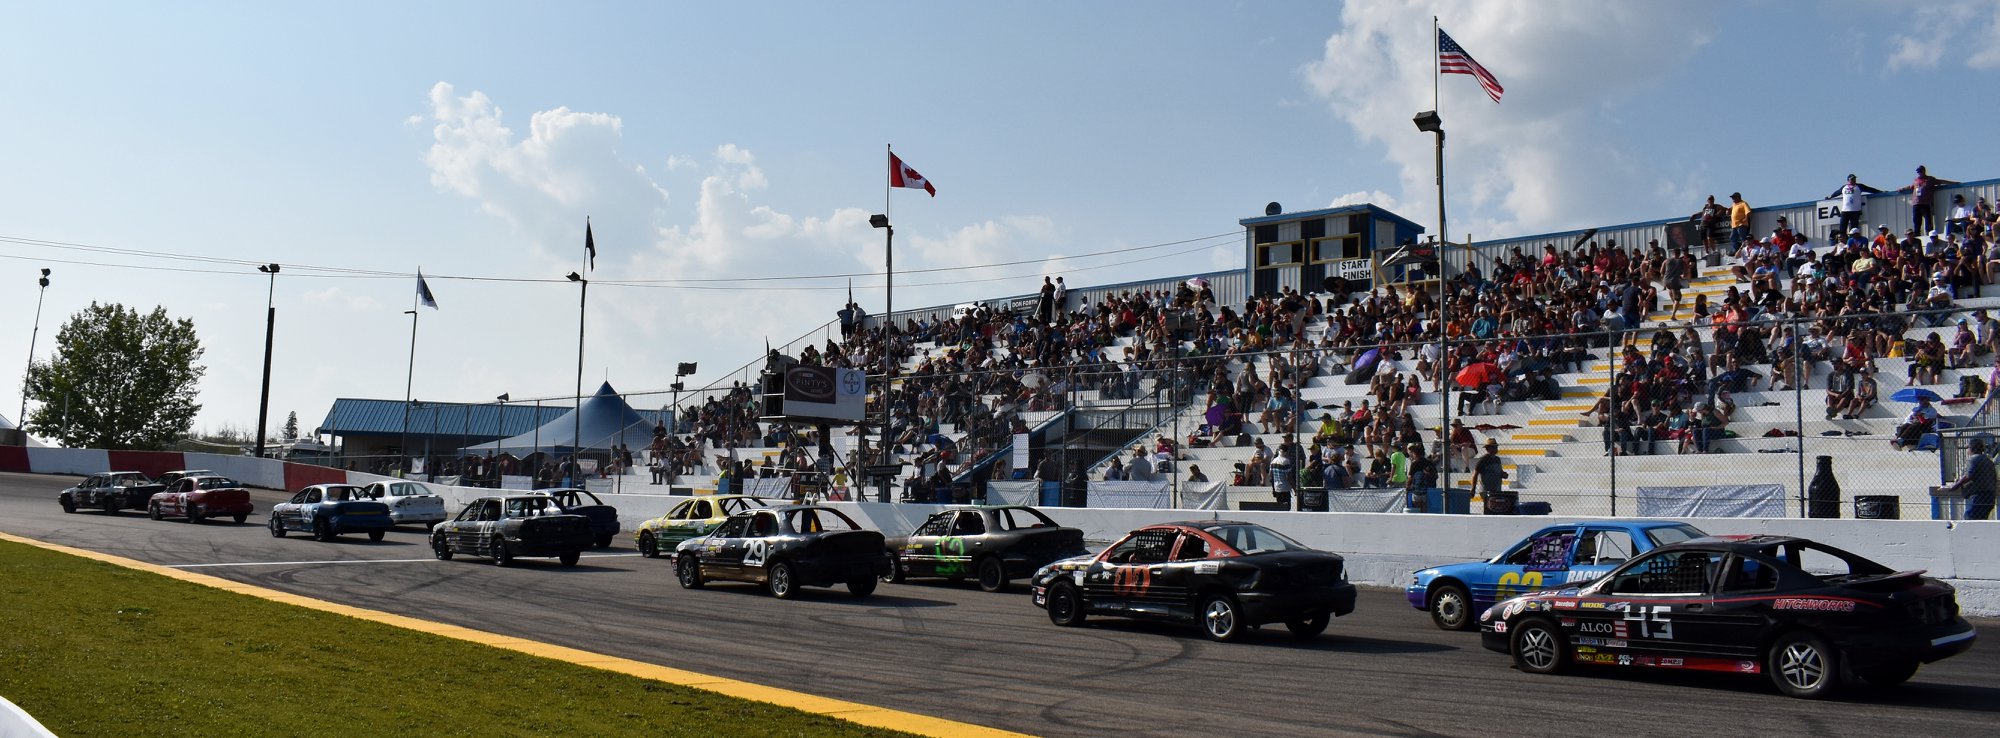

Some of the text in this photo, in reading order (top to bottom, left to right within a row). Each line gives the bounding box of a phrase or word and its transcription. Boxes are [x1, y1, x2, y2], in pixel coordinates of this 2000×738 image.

[1341, 260, 1368, 270] START
[1343, 270, 1371, 279] FINISH
[743, 540, 766, 567] 29
[1773, 599, 1856, 612] HITCHWORKS
[1580, 622, 1613, 633] ALCO
[1622, 605, 1673, 639] 45
